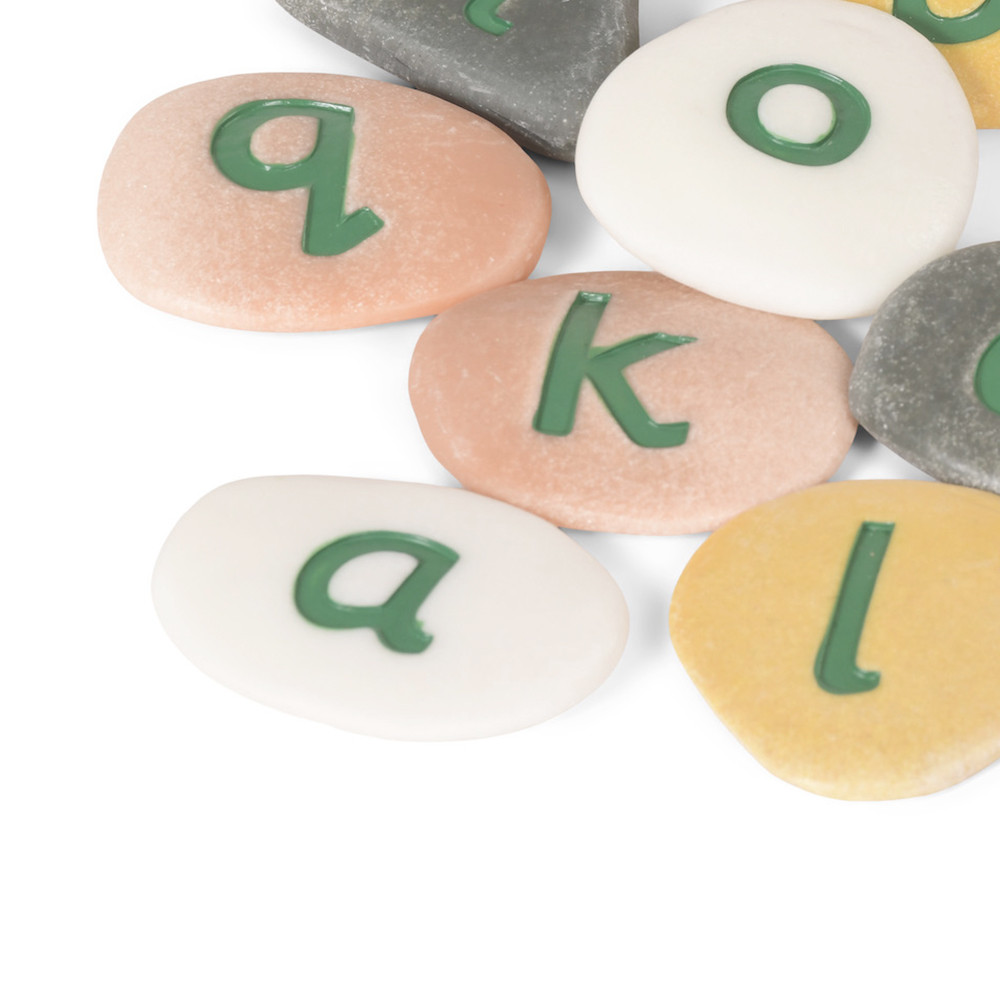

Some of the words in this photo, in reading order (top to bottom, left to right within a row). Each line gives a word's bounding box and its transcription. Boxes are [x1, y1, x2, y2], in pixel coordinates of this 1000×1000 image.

[211, 99, 385, 257] q
[726, 63, 872, 166] o
[532, 291, 698, 449] k
[293, 530, 460, 654] a
